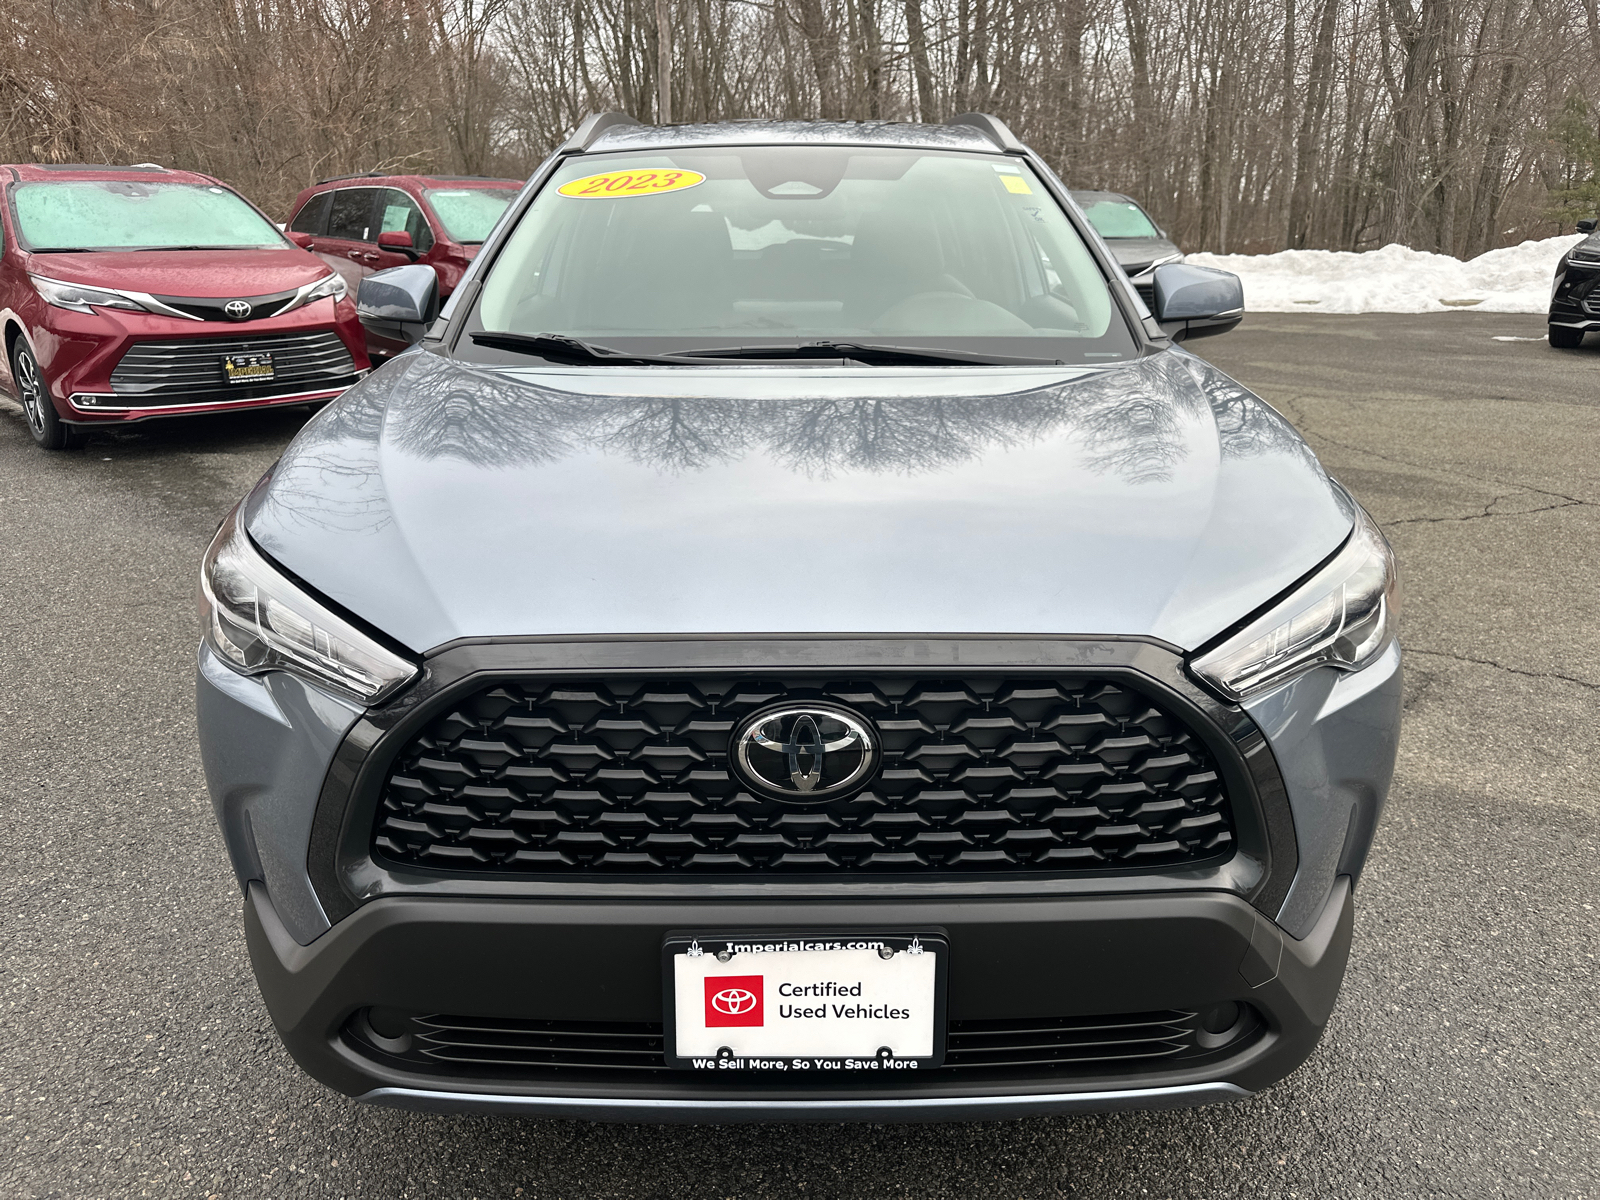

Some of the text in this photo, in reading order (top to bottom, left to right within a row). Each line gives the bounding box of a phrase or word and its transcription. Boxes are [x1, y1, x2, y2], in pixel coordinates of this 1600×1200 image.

[578, 173, 683, 195] 2023
[726, 941, 885, 954] Imperialcars.com
[779, 981, 862, 997] Certified
[779, 1003, 910, 1019] Used Vehicles
[692, 1059, 918, 1071] We Sell More, So You Save More
